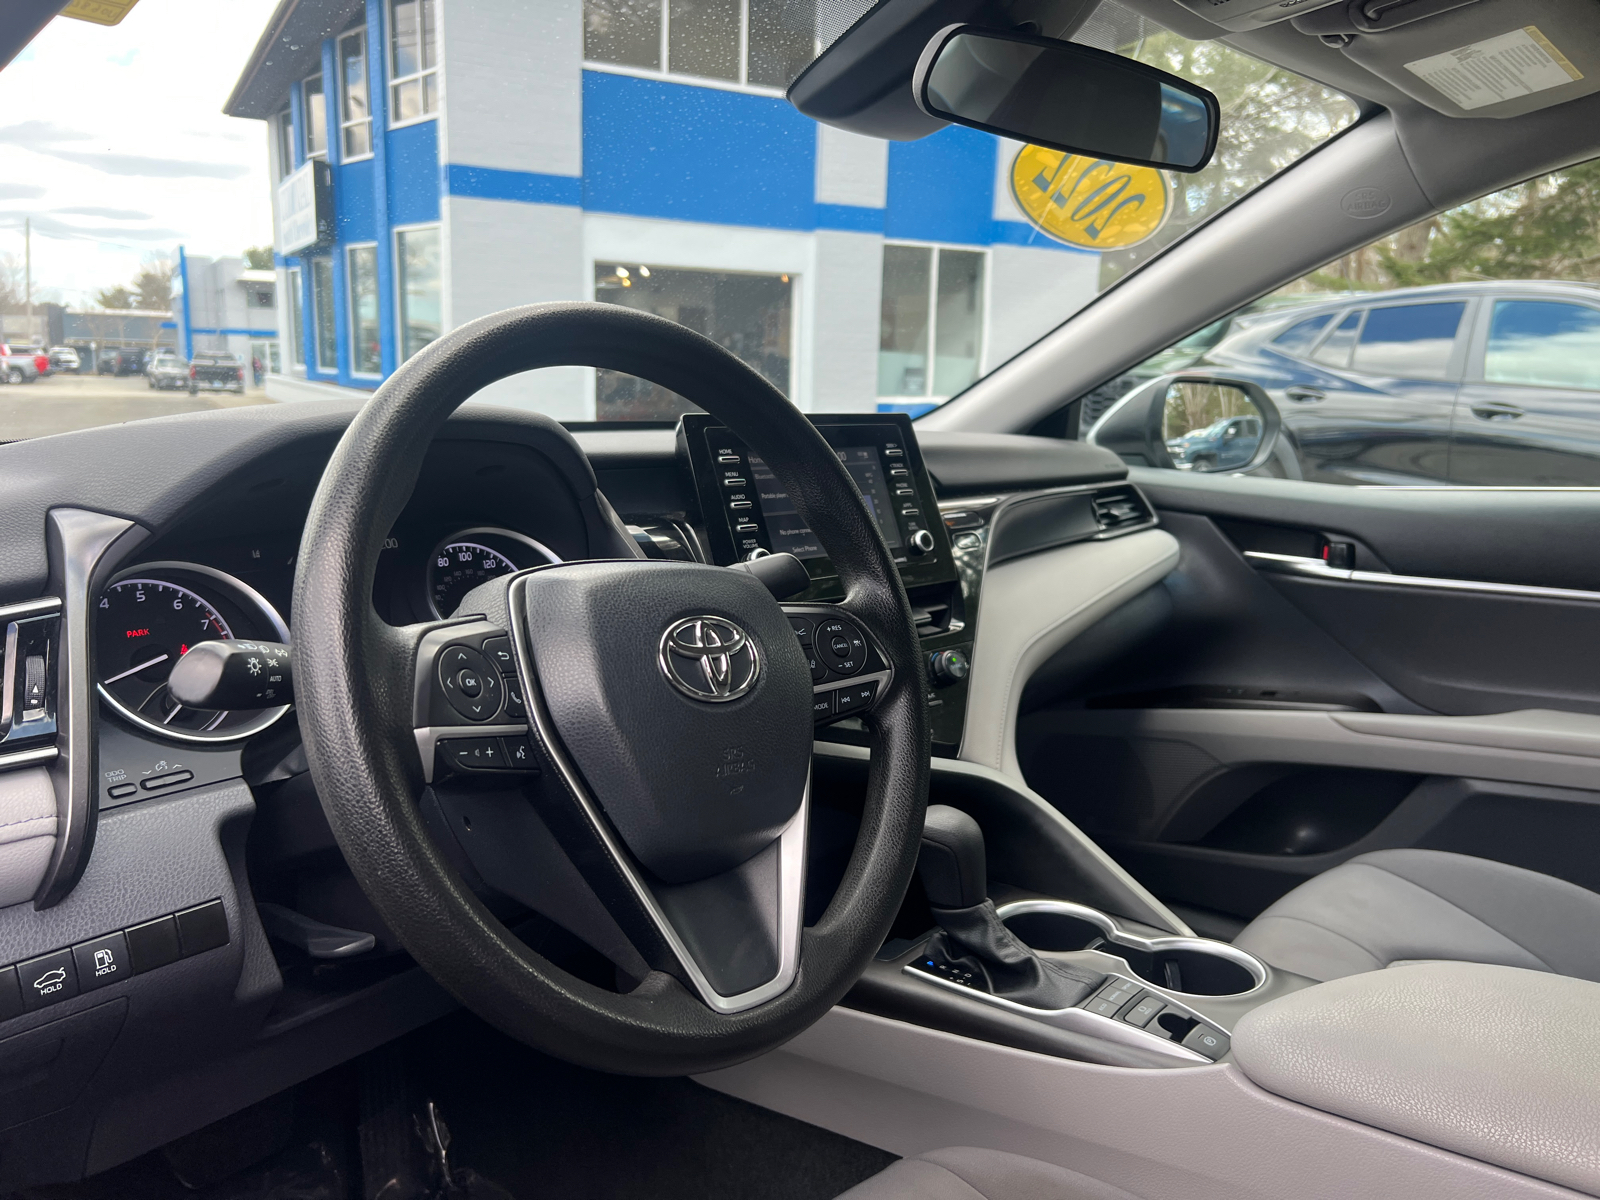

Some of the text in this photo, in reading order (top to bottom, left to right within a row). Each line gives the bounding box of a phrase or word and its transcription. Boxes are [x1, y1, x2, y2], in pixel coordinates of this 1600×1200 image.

[1355, 191, 1377, 201] SRS
[1347, 199, 1387, 212] AIRBAG
[437, 551, 497, 569] 80 100 120
[100, 591, 210, 631] 4 5 6 7
[126, 628, 150, 639] PARK
[465, 678, 477, 687] OK
[106, 774, 127, 783] TRIP
[95, 964, 117, 977] HOLD
[40, 983, 63, 996] HOLD
